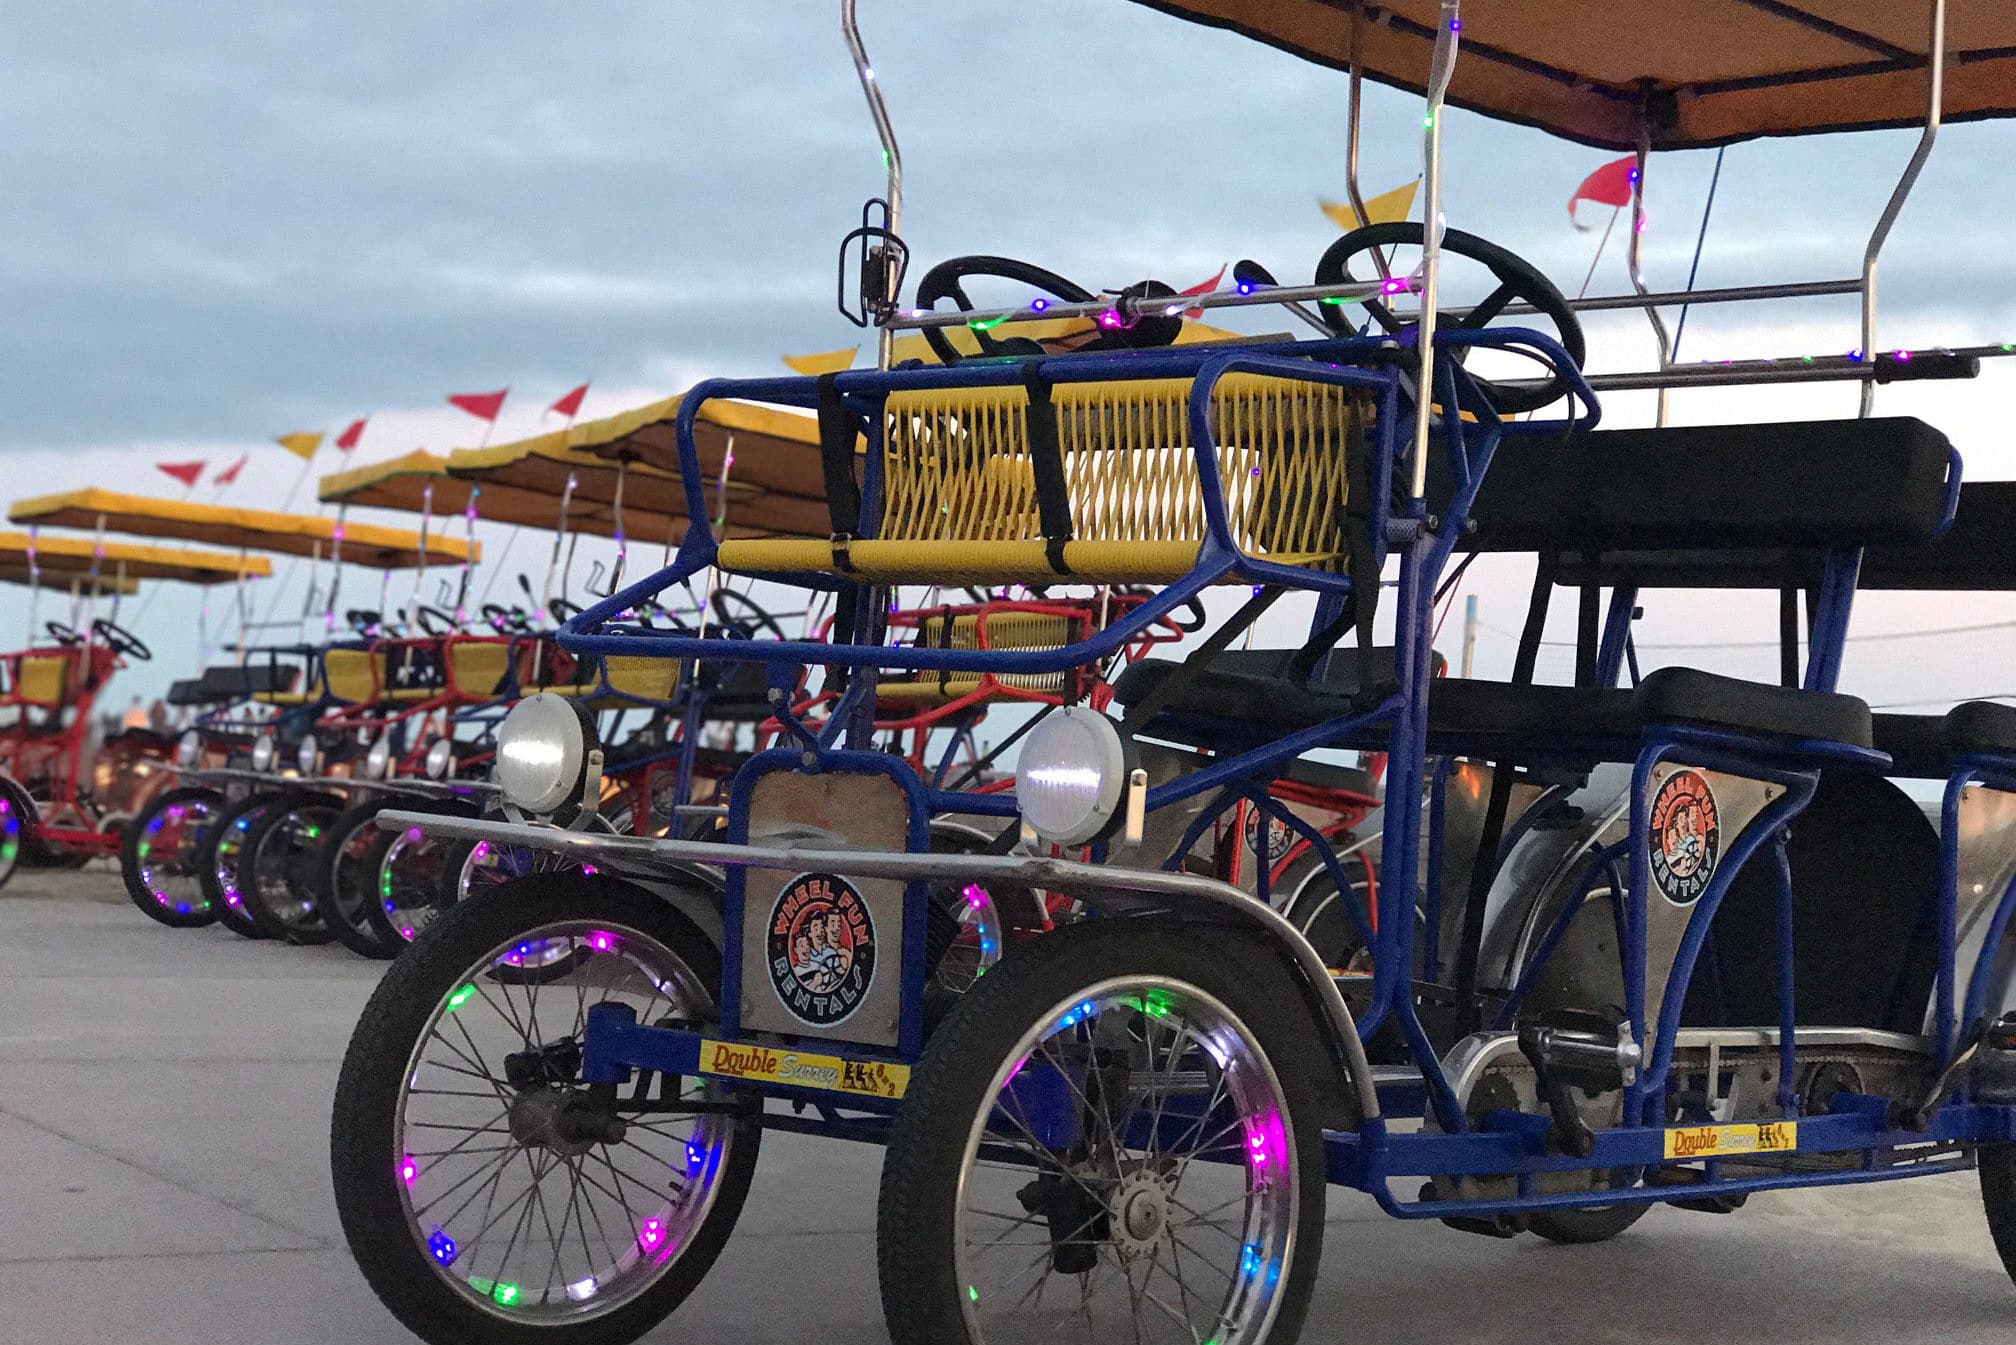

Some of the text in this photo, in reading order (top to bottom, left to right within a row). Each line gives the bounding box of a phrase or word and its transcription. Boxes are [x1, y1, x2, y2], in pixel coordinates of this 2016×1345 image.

[1652, 776, 1716, 832] WHEEL FUN
[1653, 846, 1712, 897] RENTALS
[774, 879, 869, 946] WHEEL FUN
[774, 956, 863, 1017] RENTALS
[712, 1045, 777, 1074] Double
[778, 1055, 838, 1088] Surrey
[1673, 1127, 1717, 1151] Double
